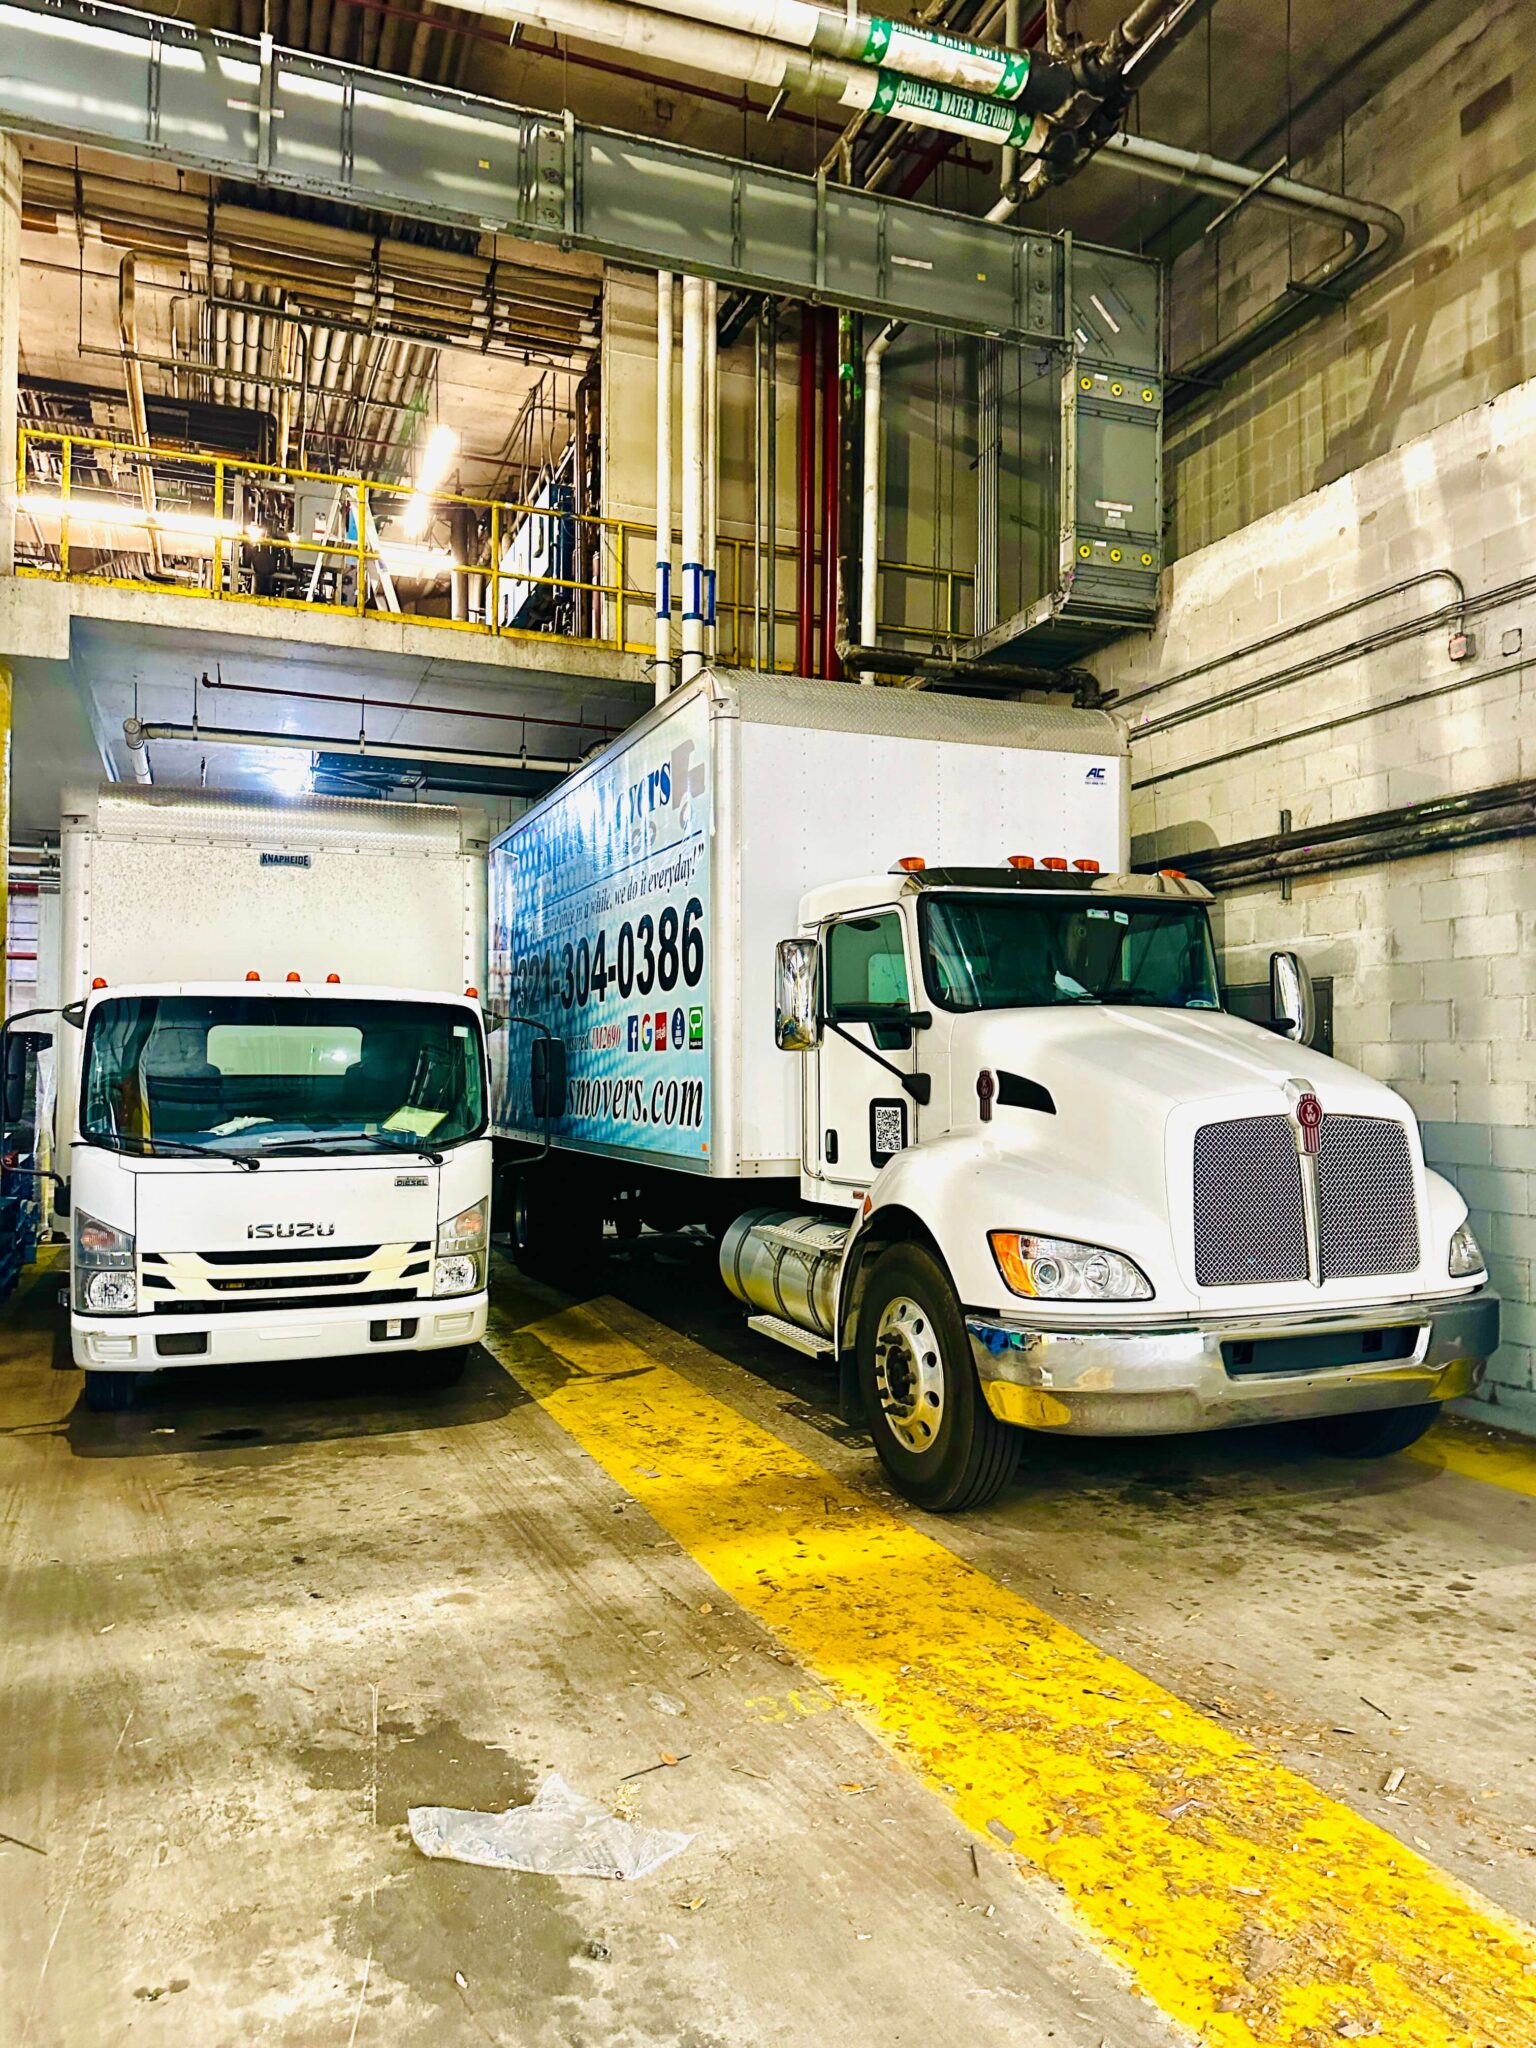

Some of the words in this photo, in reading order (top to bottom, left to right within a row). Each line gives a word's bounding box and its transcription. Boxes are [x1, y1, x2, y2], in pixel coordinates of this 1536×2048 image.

[898, 79, 939, 109] CHILLED
[940, 90, 974, 122] WATER
[975, 101, 1014, 130] RETURN
[1086, 768, 1106, 778] AC
[262, 853, 309, 866] KNAPHEIDE
[627, 875, 638, 901] do
[640, 870, 647, 896] it
[517, 897, 704, 1012] 321-304-0386
[567, 1077, 703, 1127] smovers.com
[247, 1222, 335, 1239] ISUZU
